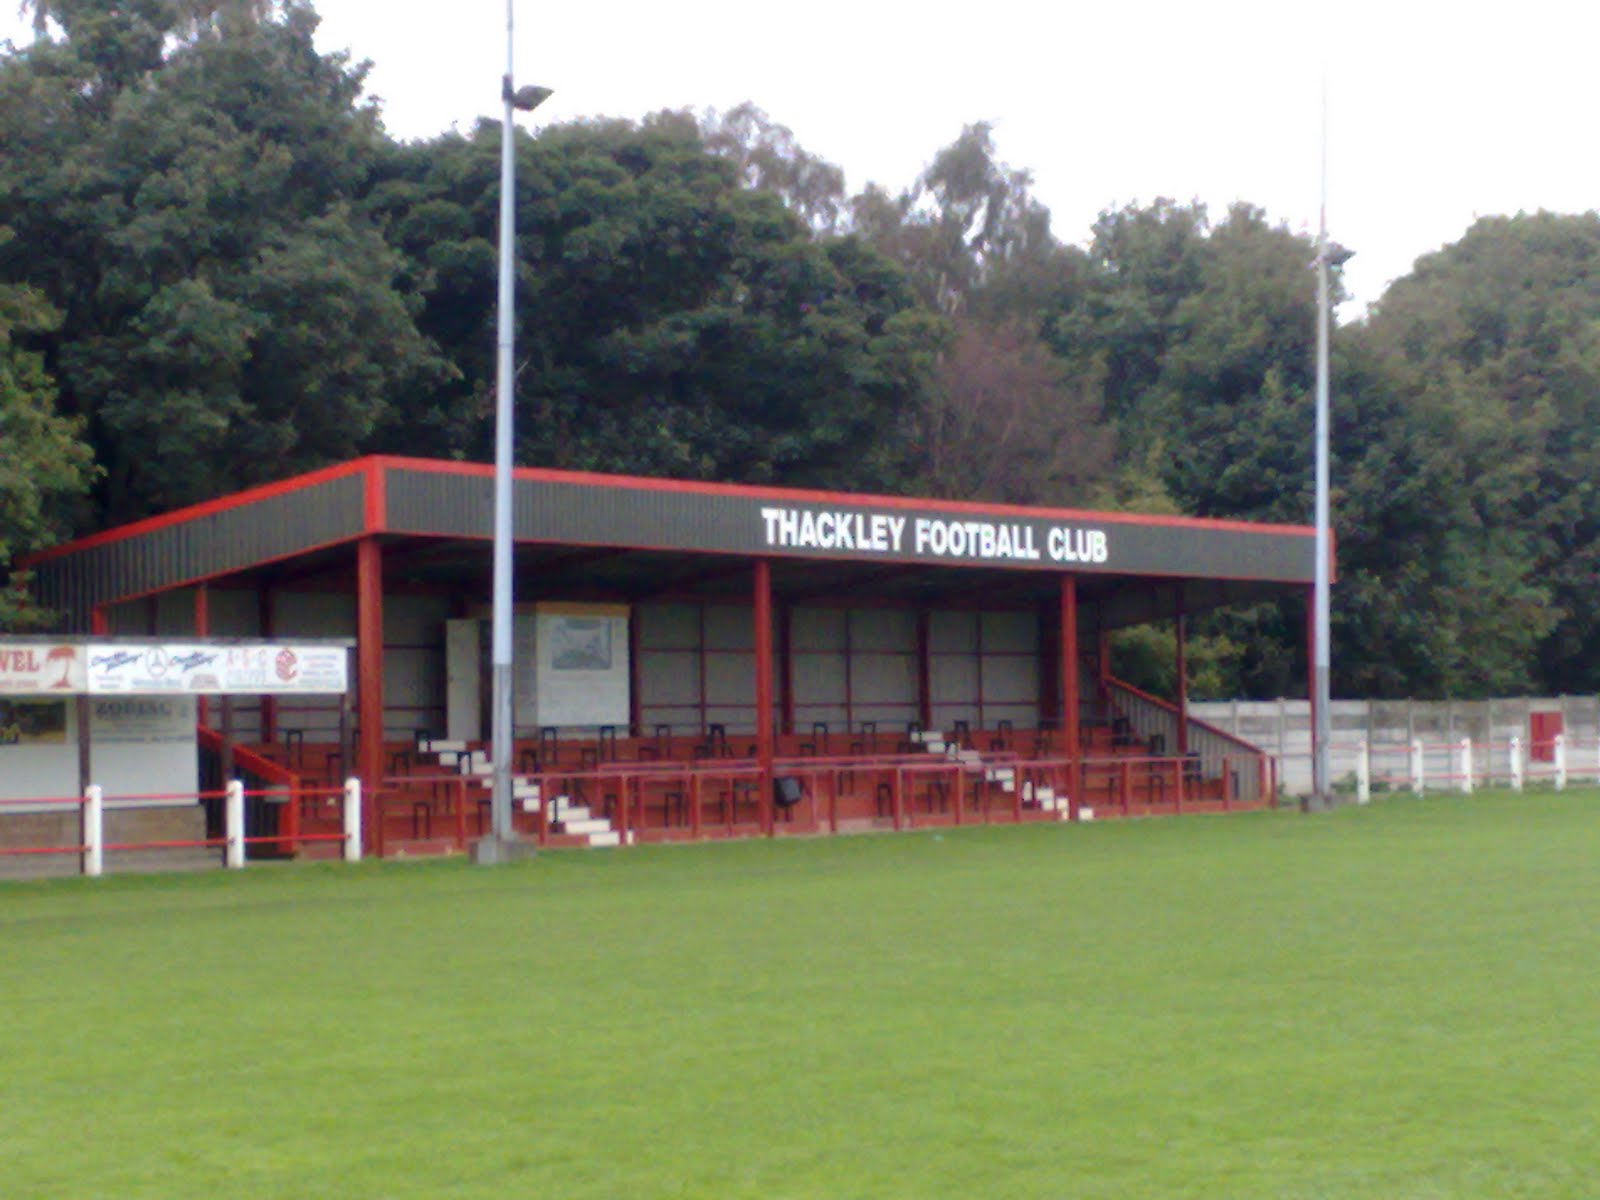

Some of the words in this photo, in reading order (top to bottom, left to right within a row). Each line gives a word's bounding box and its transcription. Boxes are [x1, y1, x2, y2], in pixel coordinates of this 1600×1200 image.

[761, 508, 905, 551] THACKLEY
[915, 519, 1040, 559] FOOTBALL
[1048, 528, 1108, 563] CLUB
